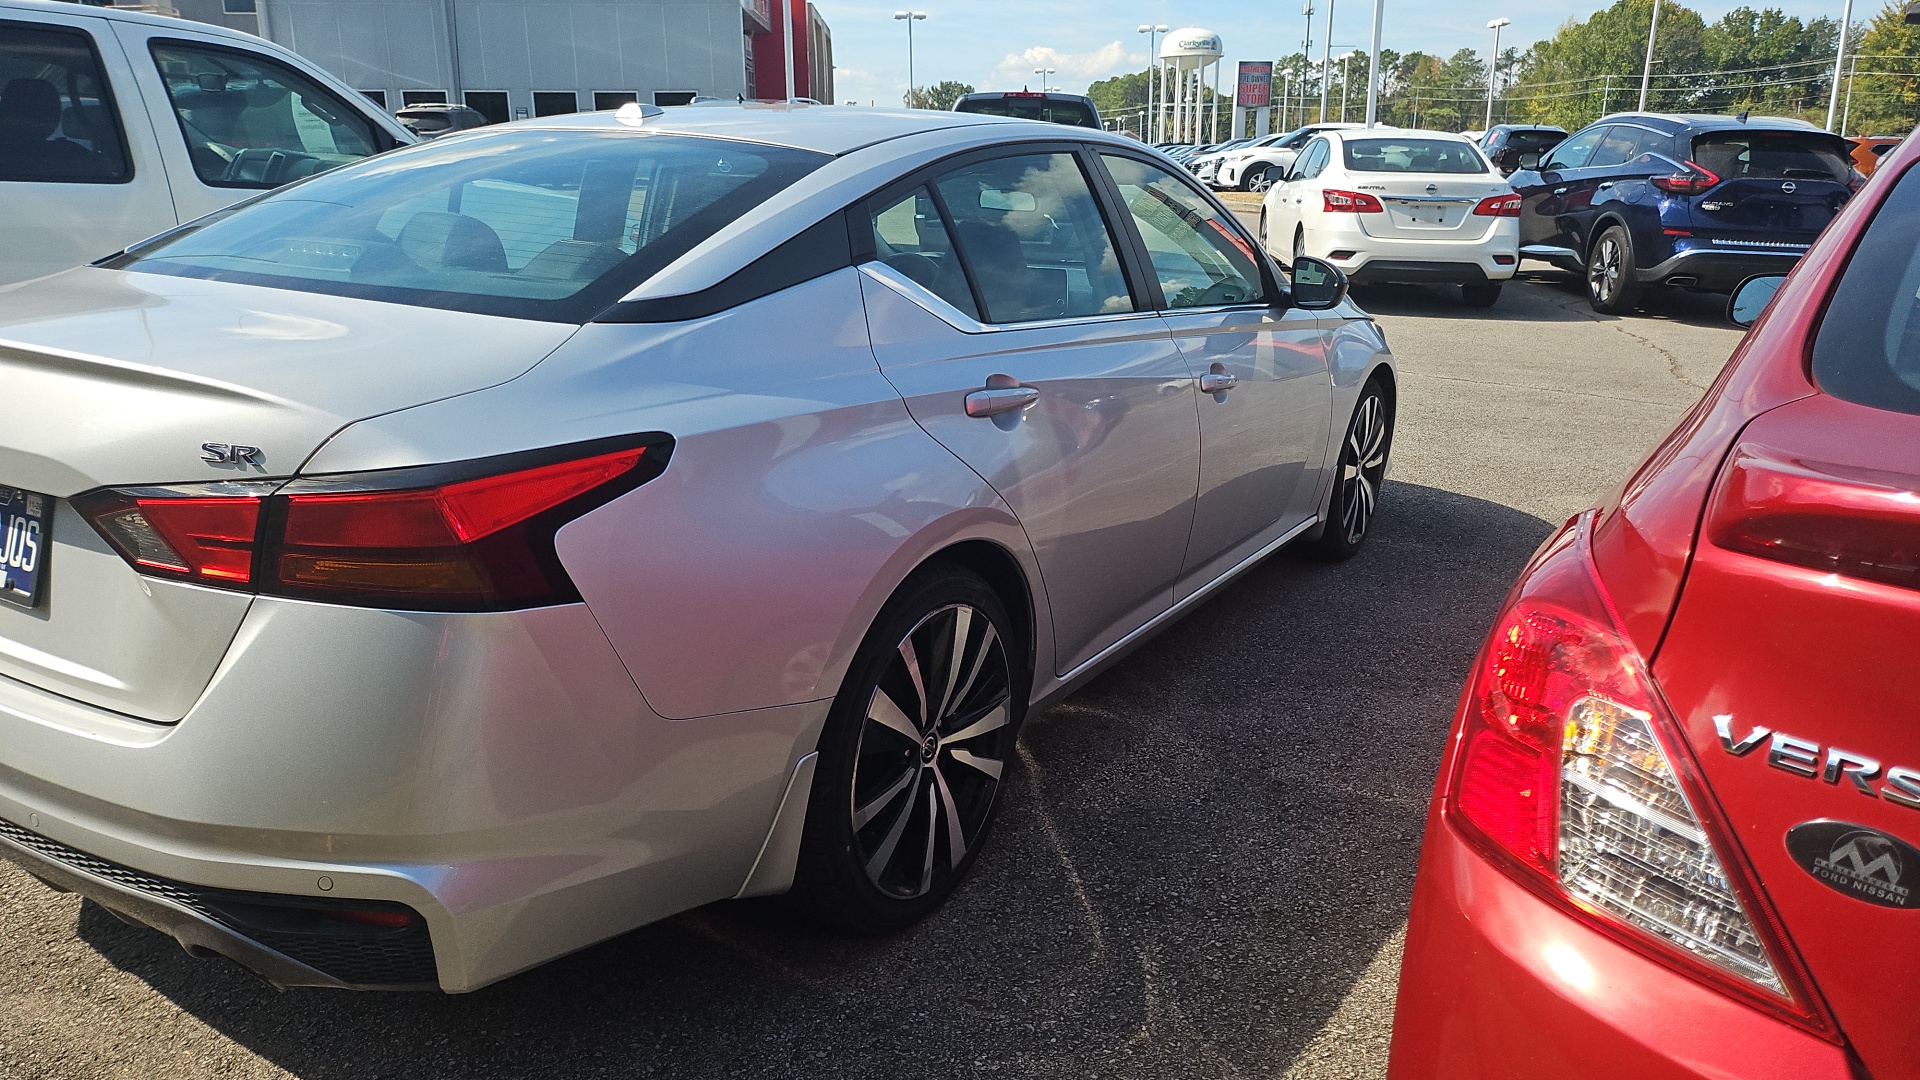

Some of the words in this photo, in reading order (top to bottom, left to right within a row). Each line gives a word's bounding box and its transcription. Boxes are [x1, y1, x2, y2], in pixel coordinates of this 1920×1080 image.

[1239, 84, 1268, 94] SUPER
[1239, 93, 1268, 105] STORE
[200, 441, 261, 466] SR
[1812, 866, 1848, 885] FORD
[1852, 880, 1905, 906] NISSAN
